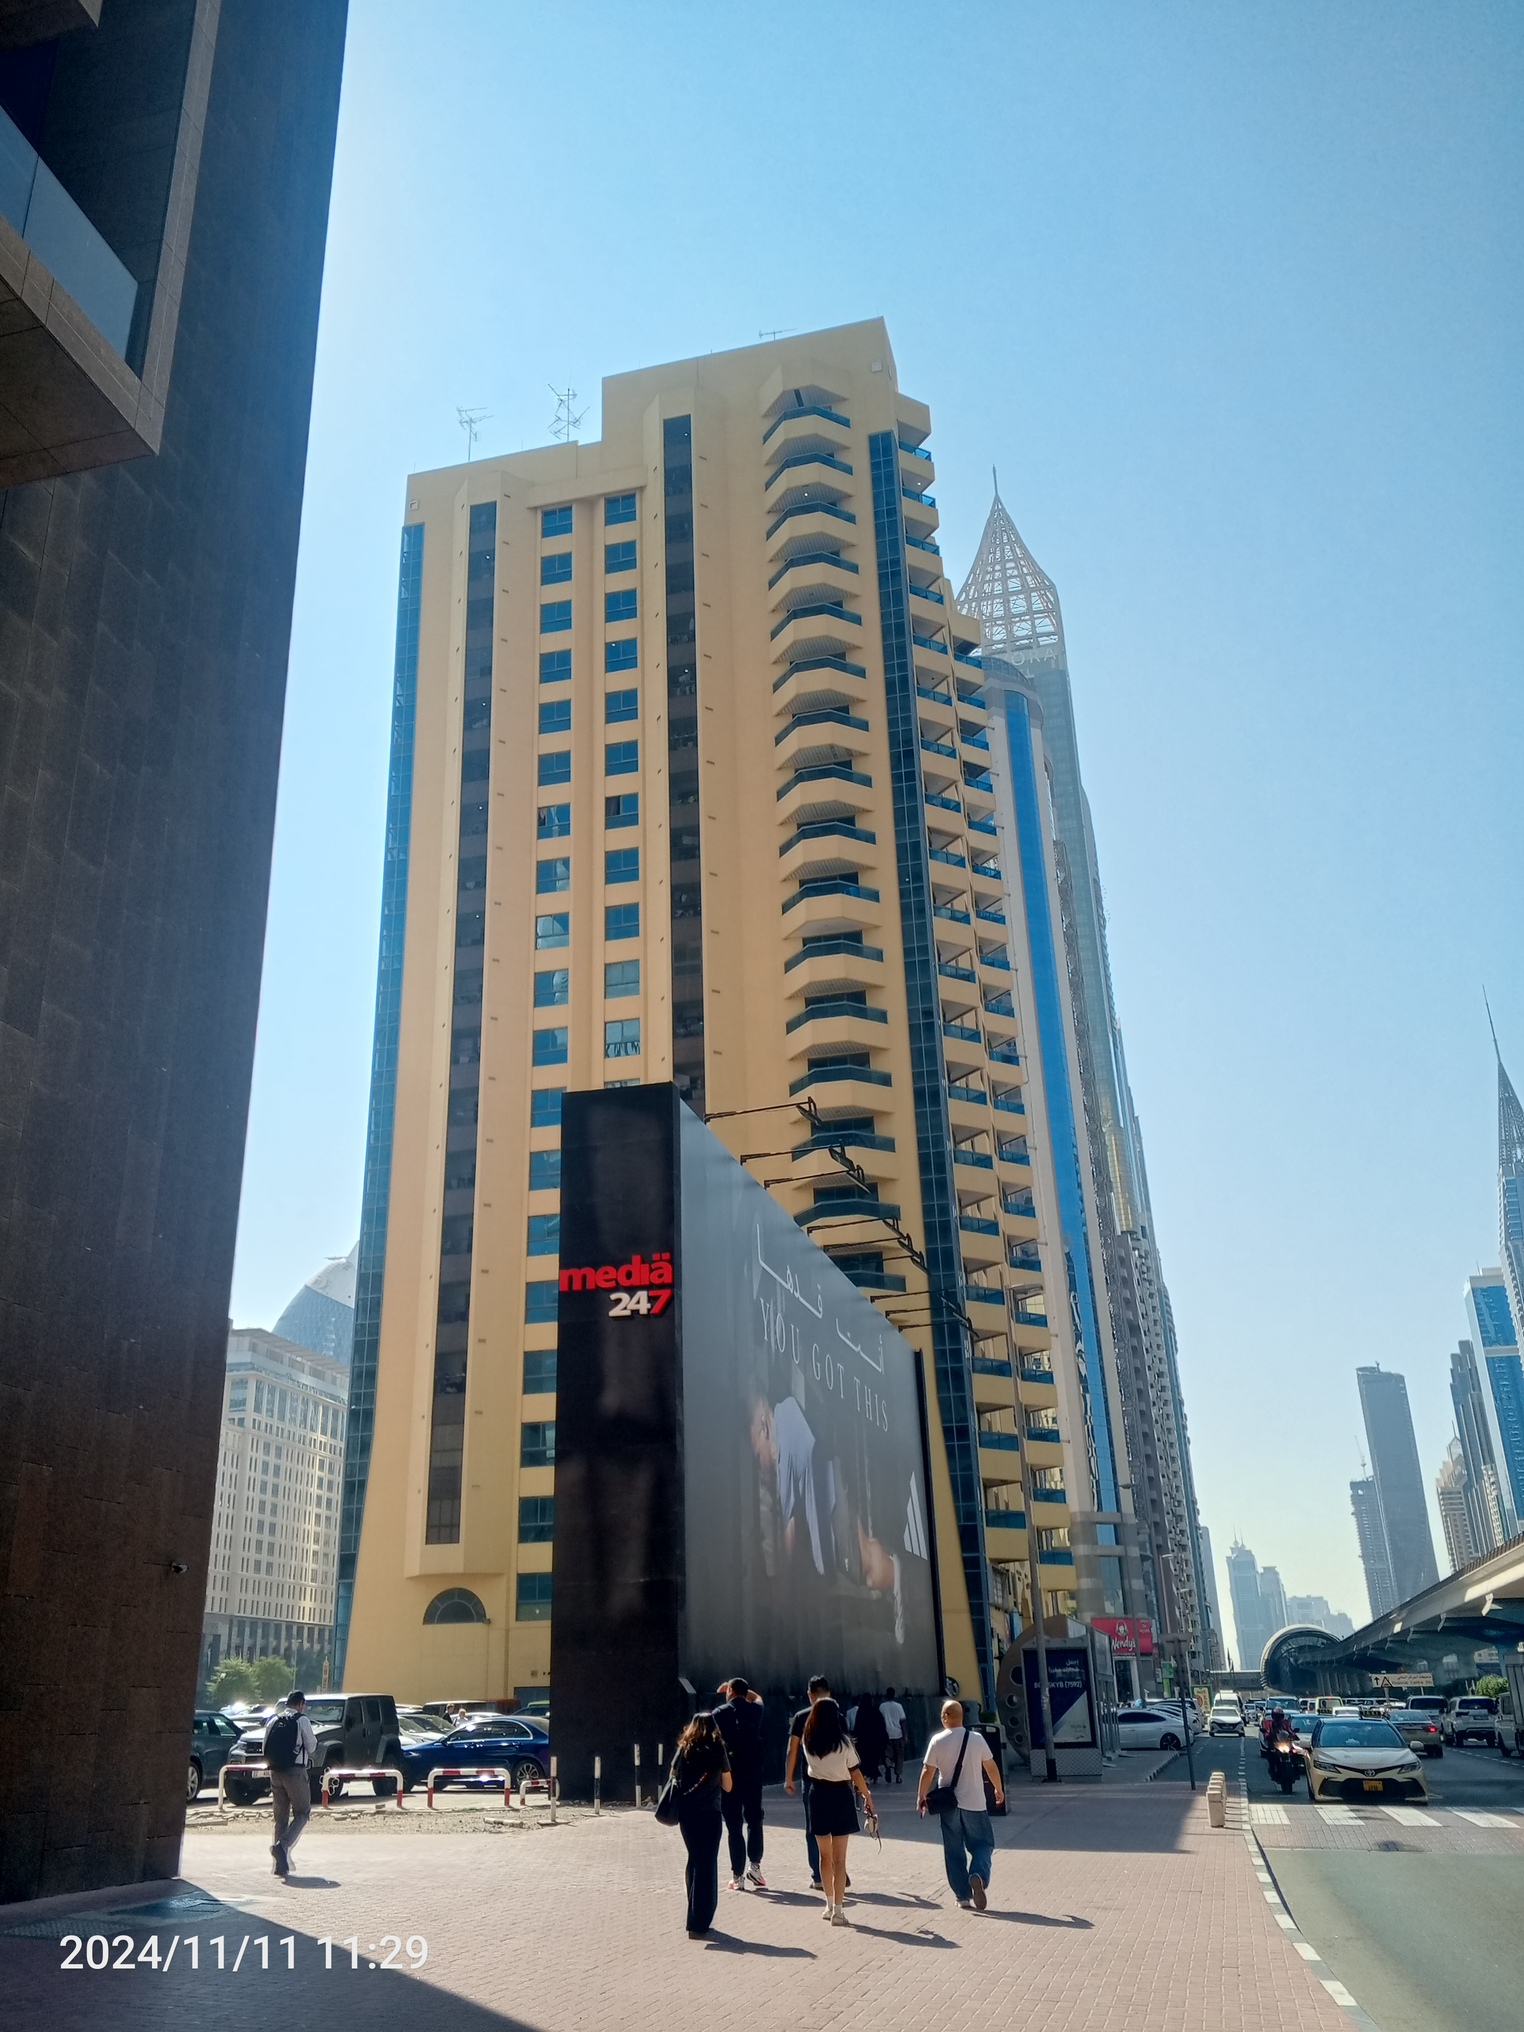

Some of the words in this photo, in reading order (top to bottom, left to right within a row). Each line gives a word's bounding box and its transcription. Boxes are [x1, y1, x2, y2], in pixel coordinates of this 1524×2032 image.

[608, 1289, 672, 1317] 247
[759, 1297, 801, 1366] YOU
[812, 1342, 846, 1400] GOT
[854, 1376, 890, 1433] THIS
